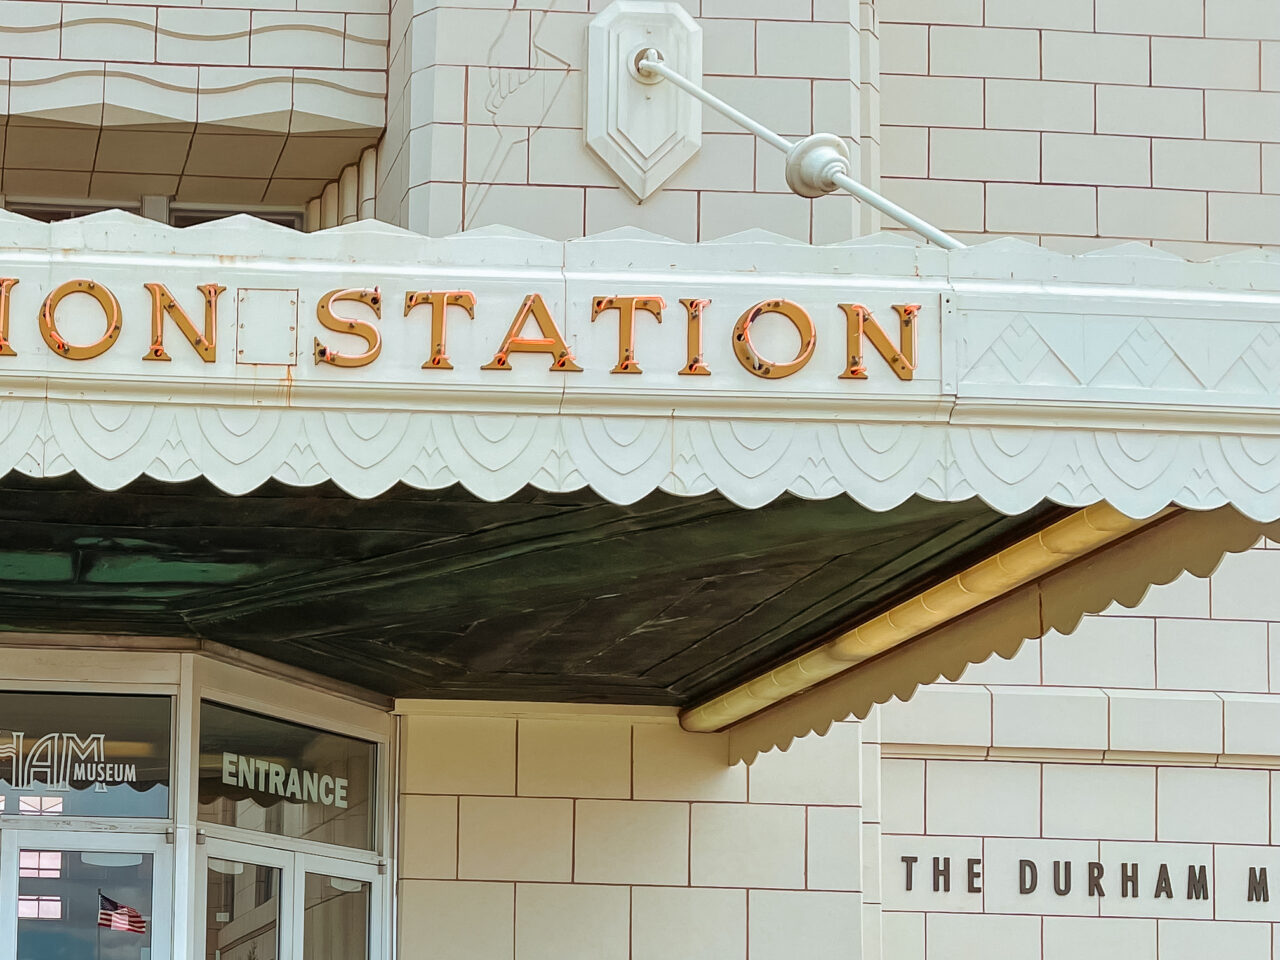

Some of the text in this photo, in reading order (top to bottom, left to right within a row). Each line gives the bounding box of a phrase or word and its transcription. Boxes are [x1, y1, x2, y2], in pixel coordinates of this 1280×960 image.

[314, 285, 922, 383] STATION
[73, 763, 137, 783] MUSEUM
[222, 751, 348, 809] ENTRANCE
[901, 855, 983, 894] THE
[1019, 859, 1209, 900] DURHAM
